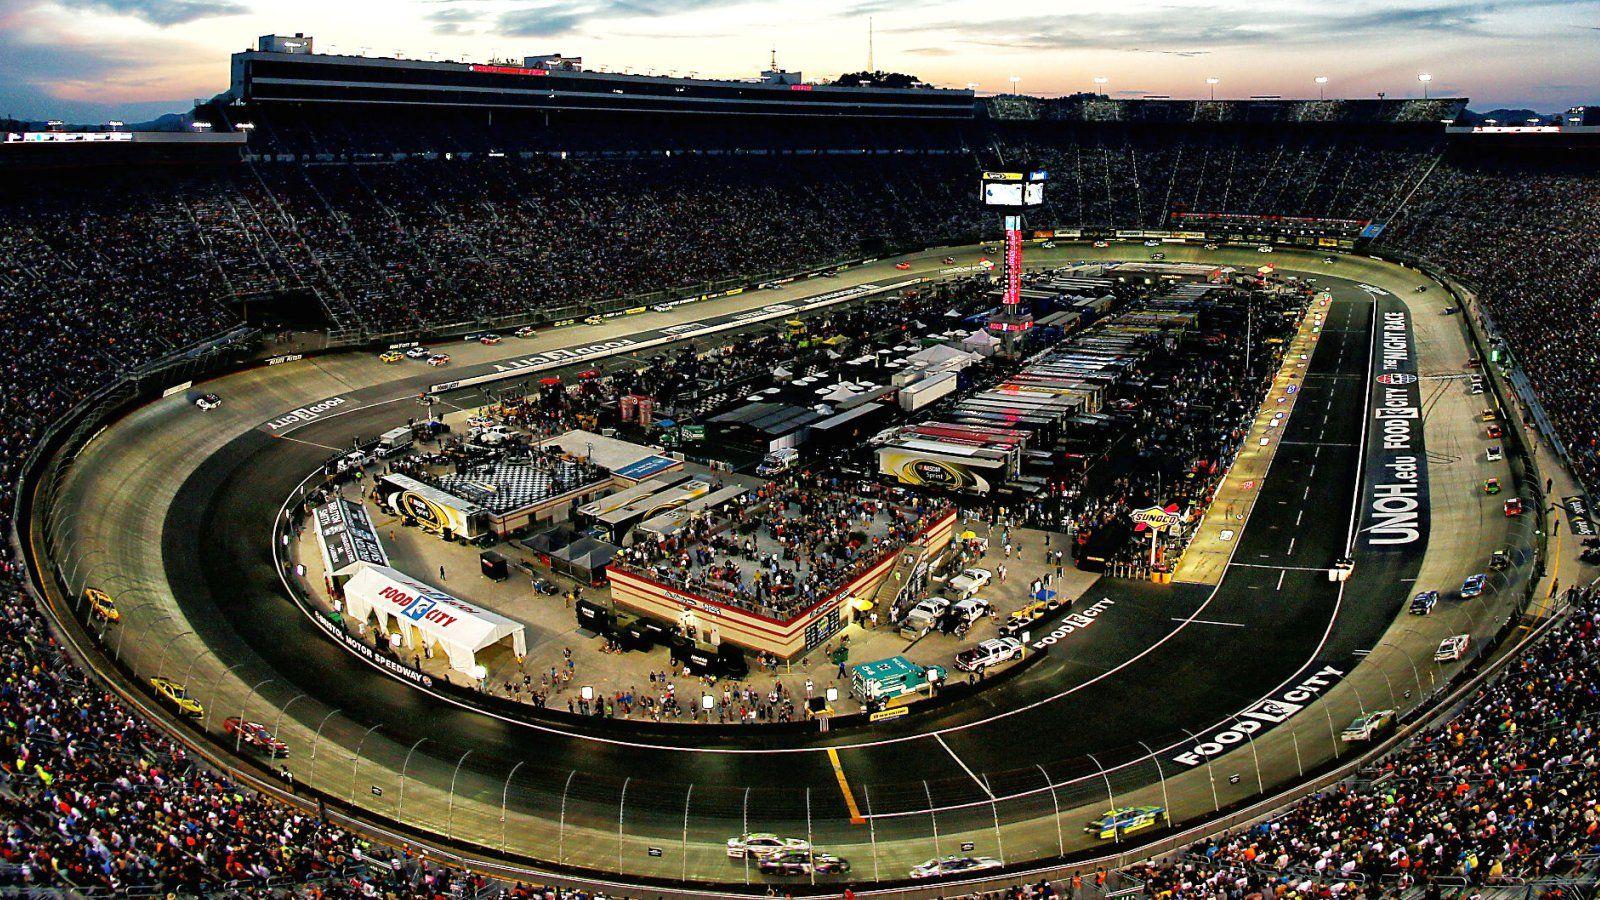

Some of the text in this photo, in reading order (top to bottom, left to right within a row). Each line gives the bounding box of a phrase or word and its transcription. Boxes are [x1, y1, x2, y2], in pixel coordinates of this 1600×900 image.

[1384, 312, 1405, 330] RACE
[1383, 332, 1408, 360] NIGHT
[1384, 387, 1409, 408] CITY
[267, 397, 345, 430] FOOD CITY
[1383, 419, 1411, 449] FOOD
[925, 472, 943, 480] Sprint
[1136, 513, 1176, 523] SUNOCO
[378, 586, 457, 628] FOOD CITY
[1033, 597, 1115, 649] FOOD CITY
[317, 614, 423, 682] BRISTOL MOTOR SPEEDWAY
[1172, 665, 1344, 766] FOOD CITY
